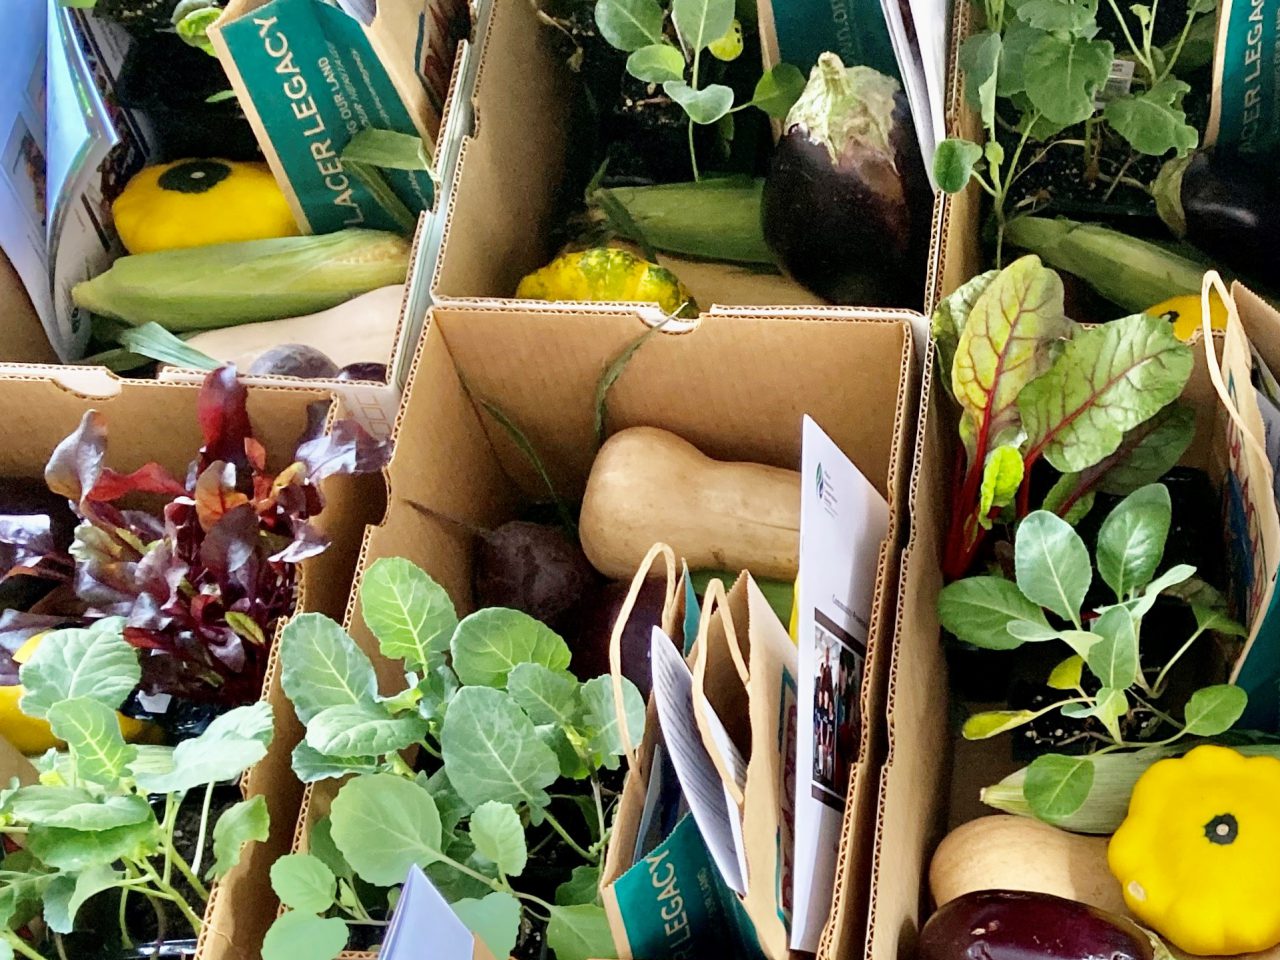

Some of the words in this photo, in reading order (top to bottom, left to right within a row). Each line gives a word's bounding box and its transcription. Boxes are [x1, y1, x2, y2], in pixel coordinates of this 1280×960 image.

[252, 15, 328, 138] LEGACY
[316, 56, 344, 92] LAND
[1243, 0, 1265, 84] LEGA
[309, 138, 365, 226] LACER
[645, 848, 692, 950] LEGACY
